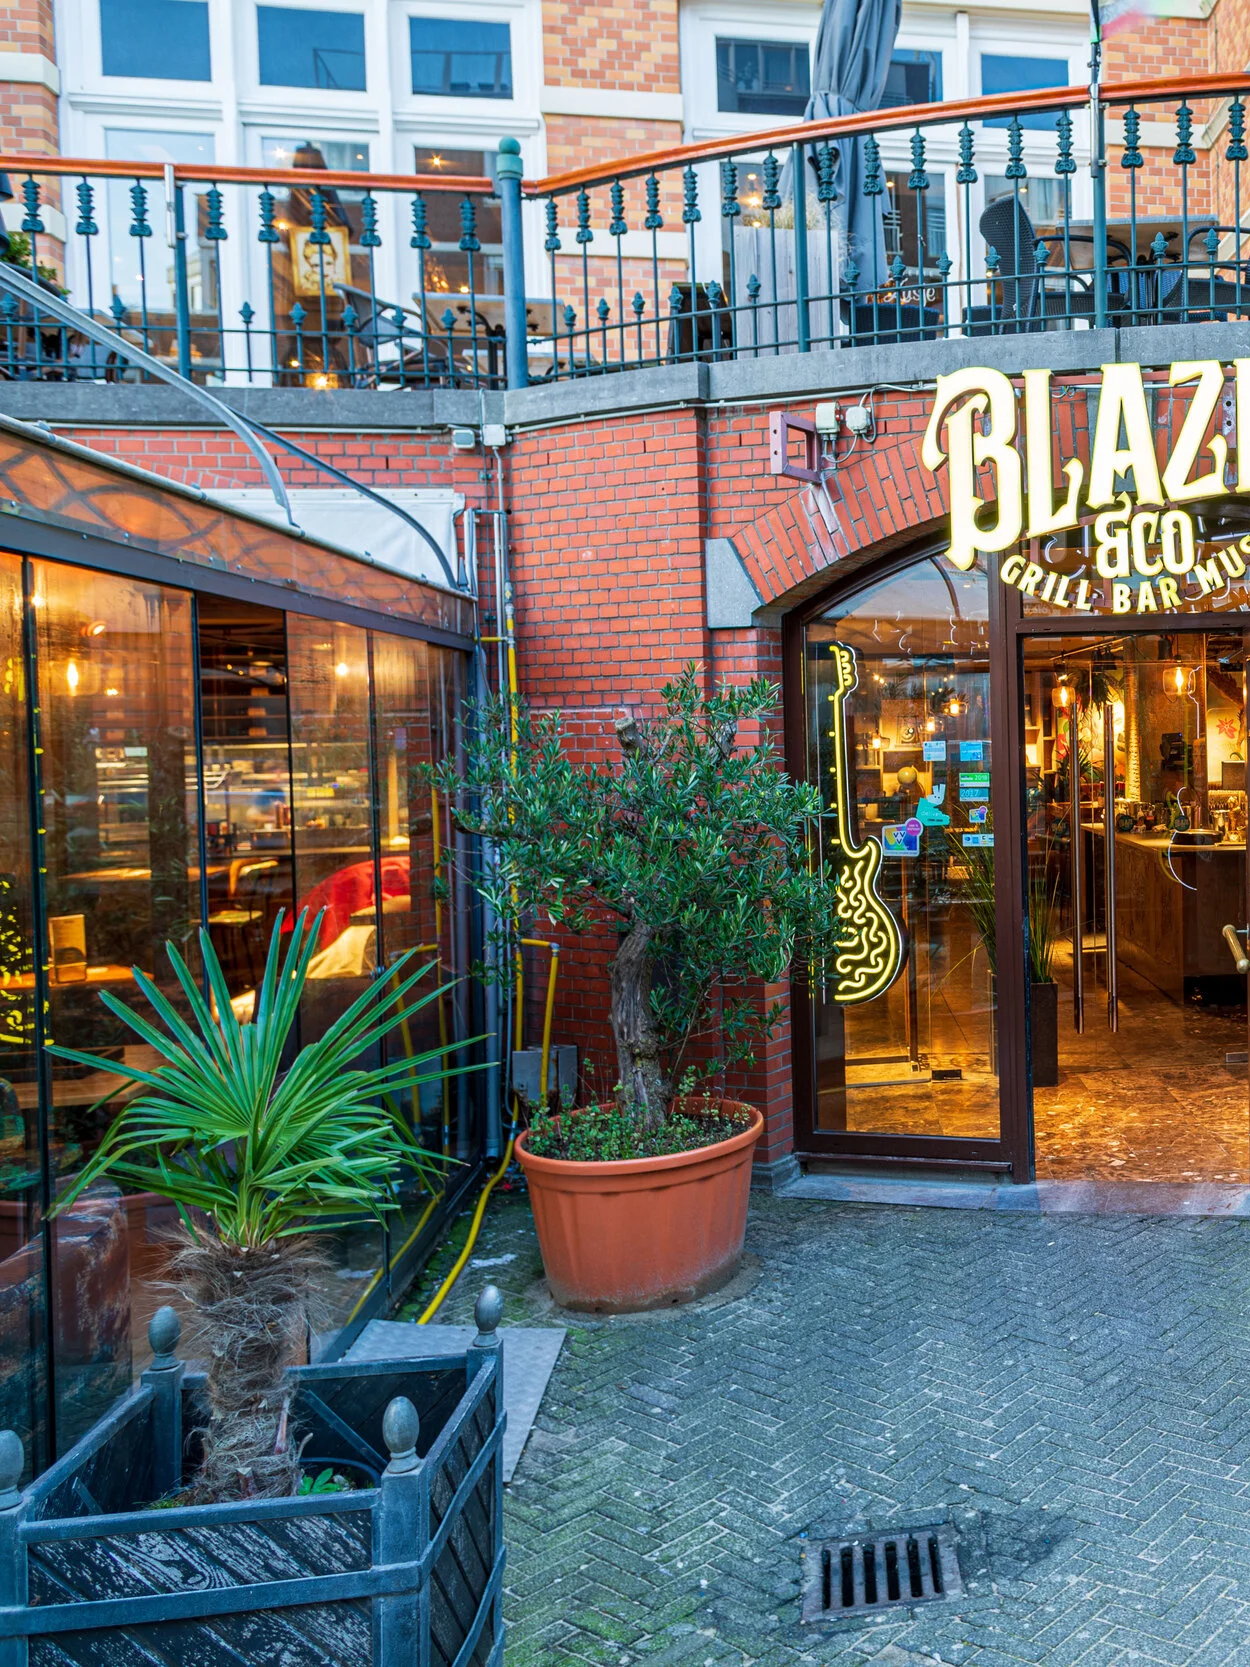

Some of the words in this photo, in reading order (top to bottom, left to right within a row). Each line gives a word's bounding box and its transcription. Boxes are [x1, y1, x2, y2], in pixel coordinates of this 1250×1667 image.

[1095, 491, 1196, 579] &CO
[1000, 554, 1092, 612] GRILL
[1113, 577, 1183, 614] BAR
